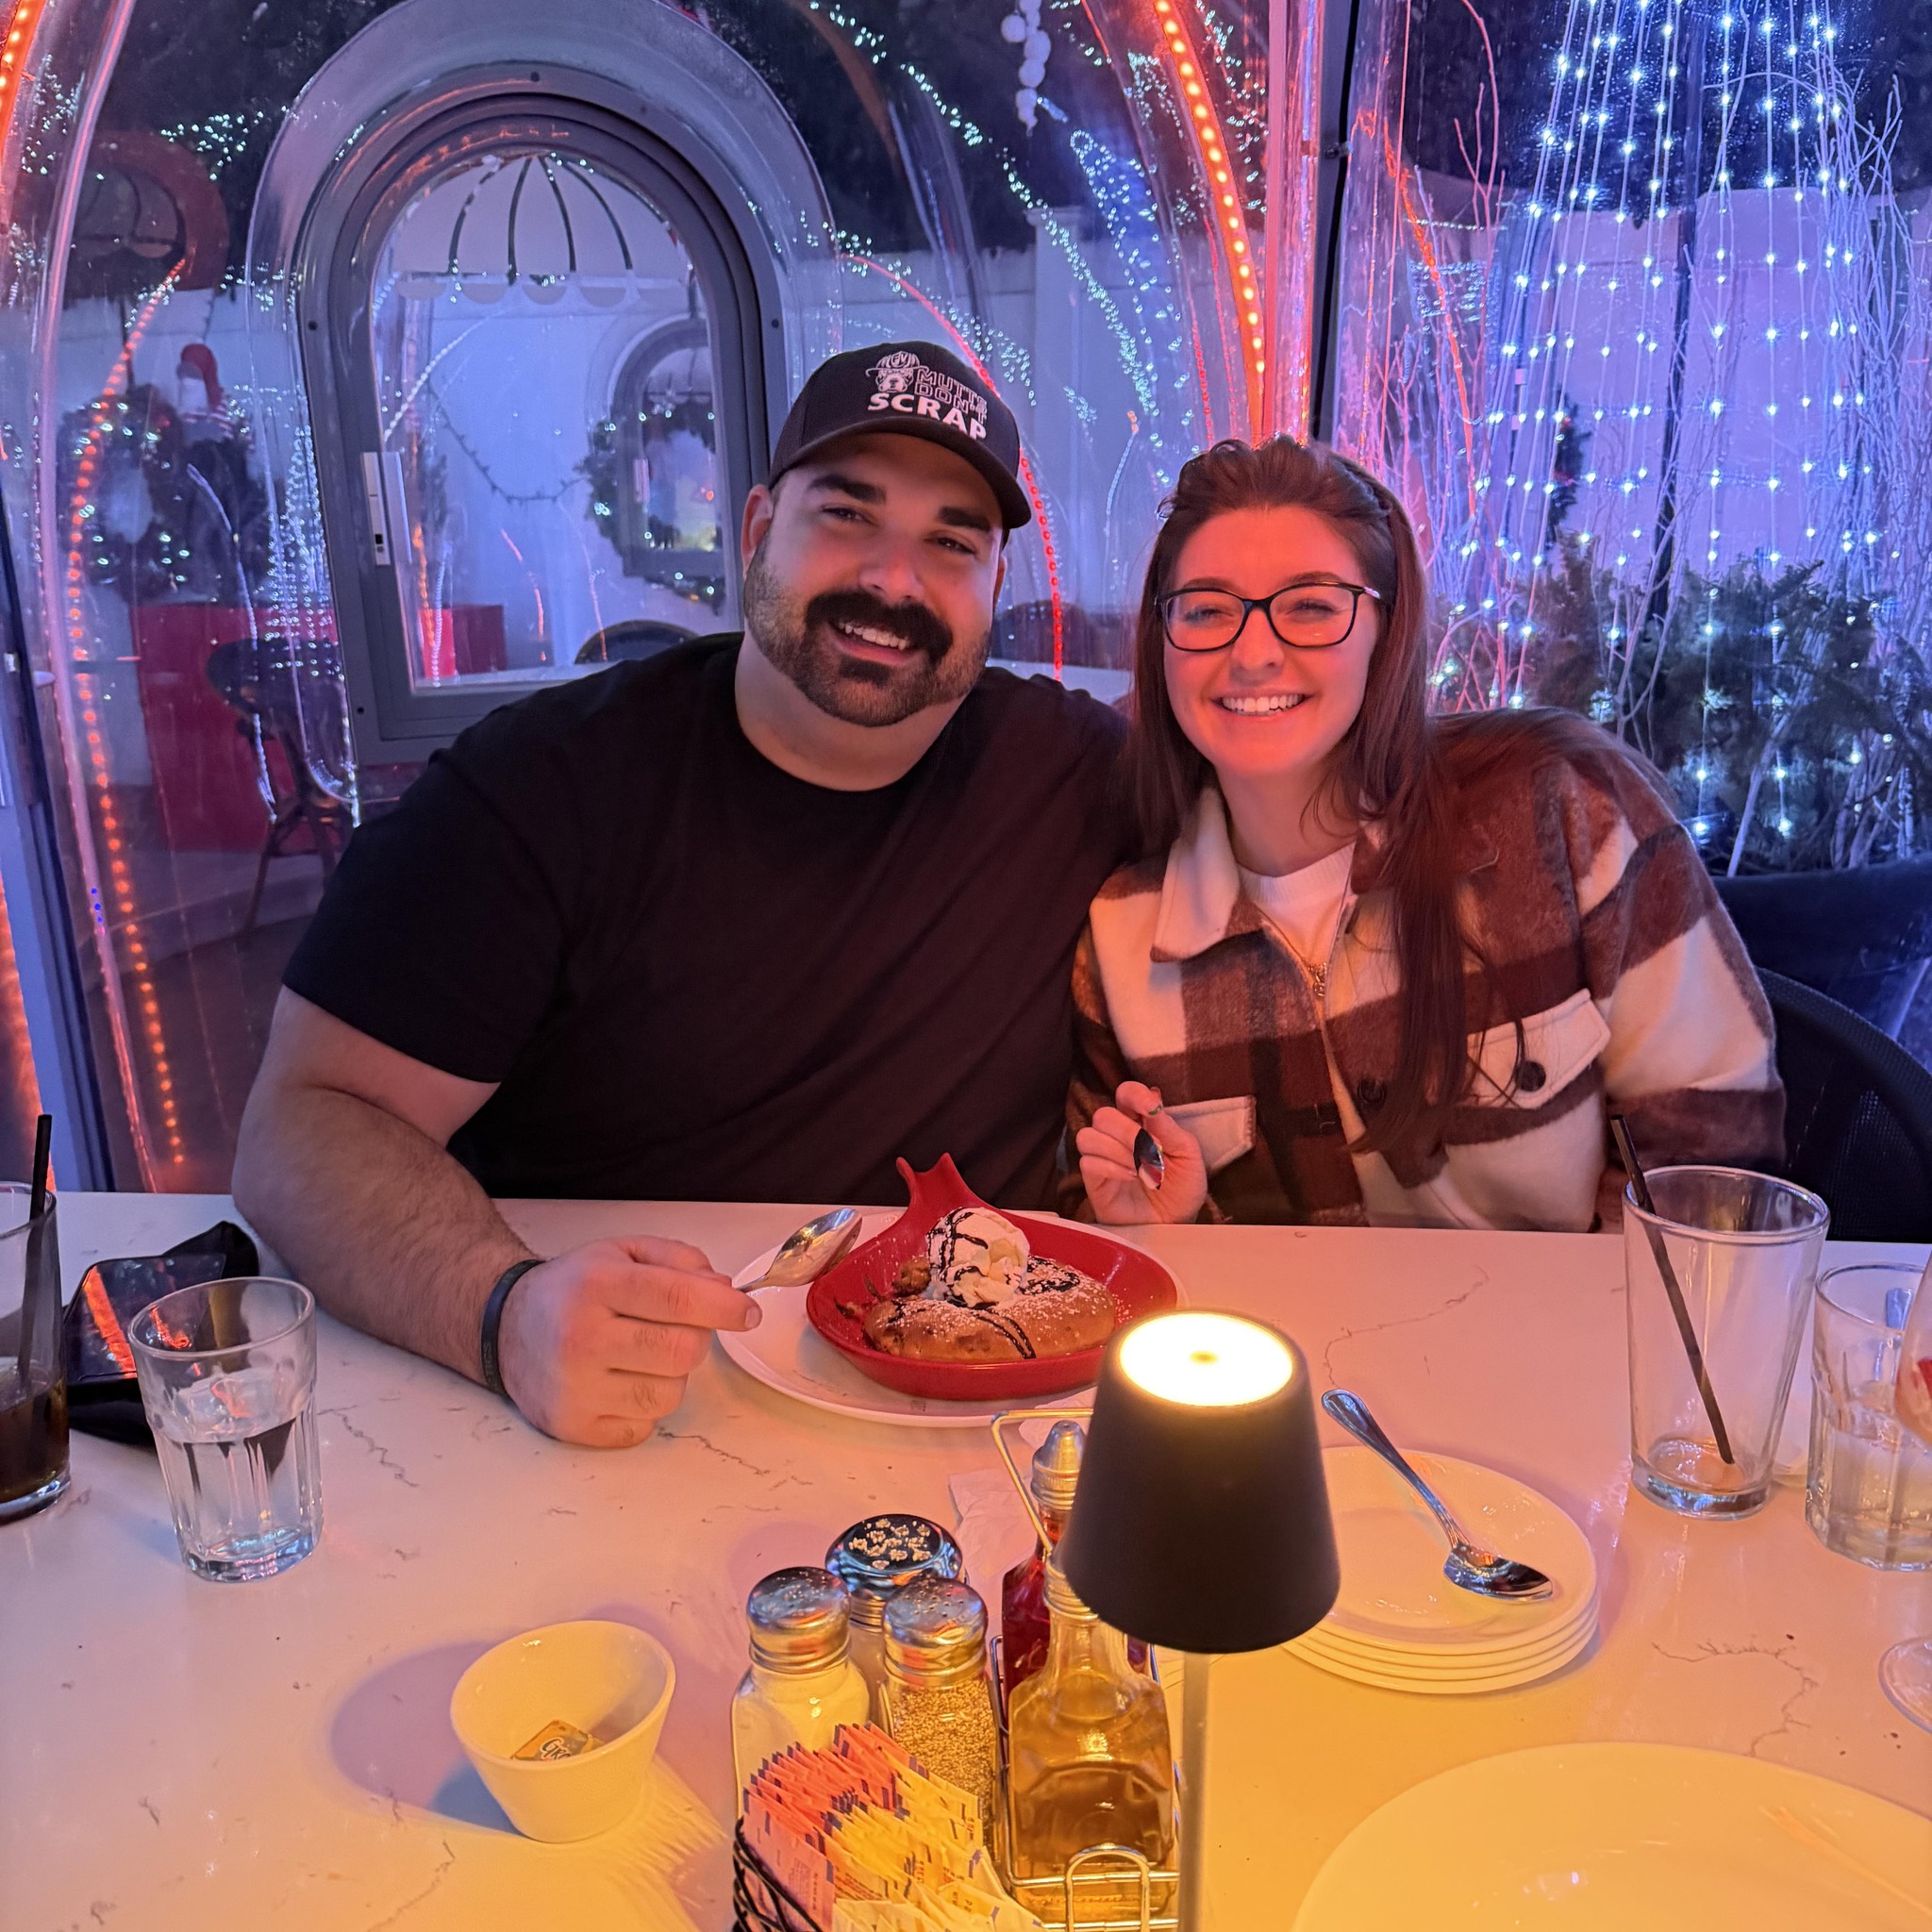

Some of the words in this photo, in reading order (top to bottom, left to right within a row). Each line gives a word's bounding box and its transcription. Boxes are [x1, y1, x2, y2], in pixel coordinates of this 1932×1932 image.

[914, 381, 988, 425] DON'T
[915, 368, 988, 413] MUTTS
[868, 392, 987, 440] SCRAP
